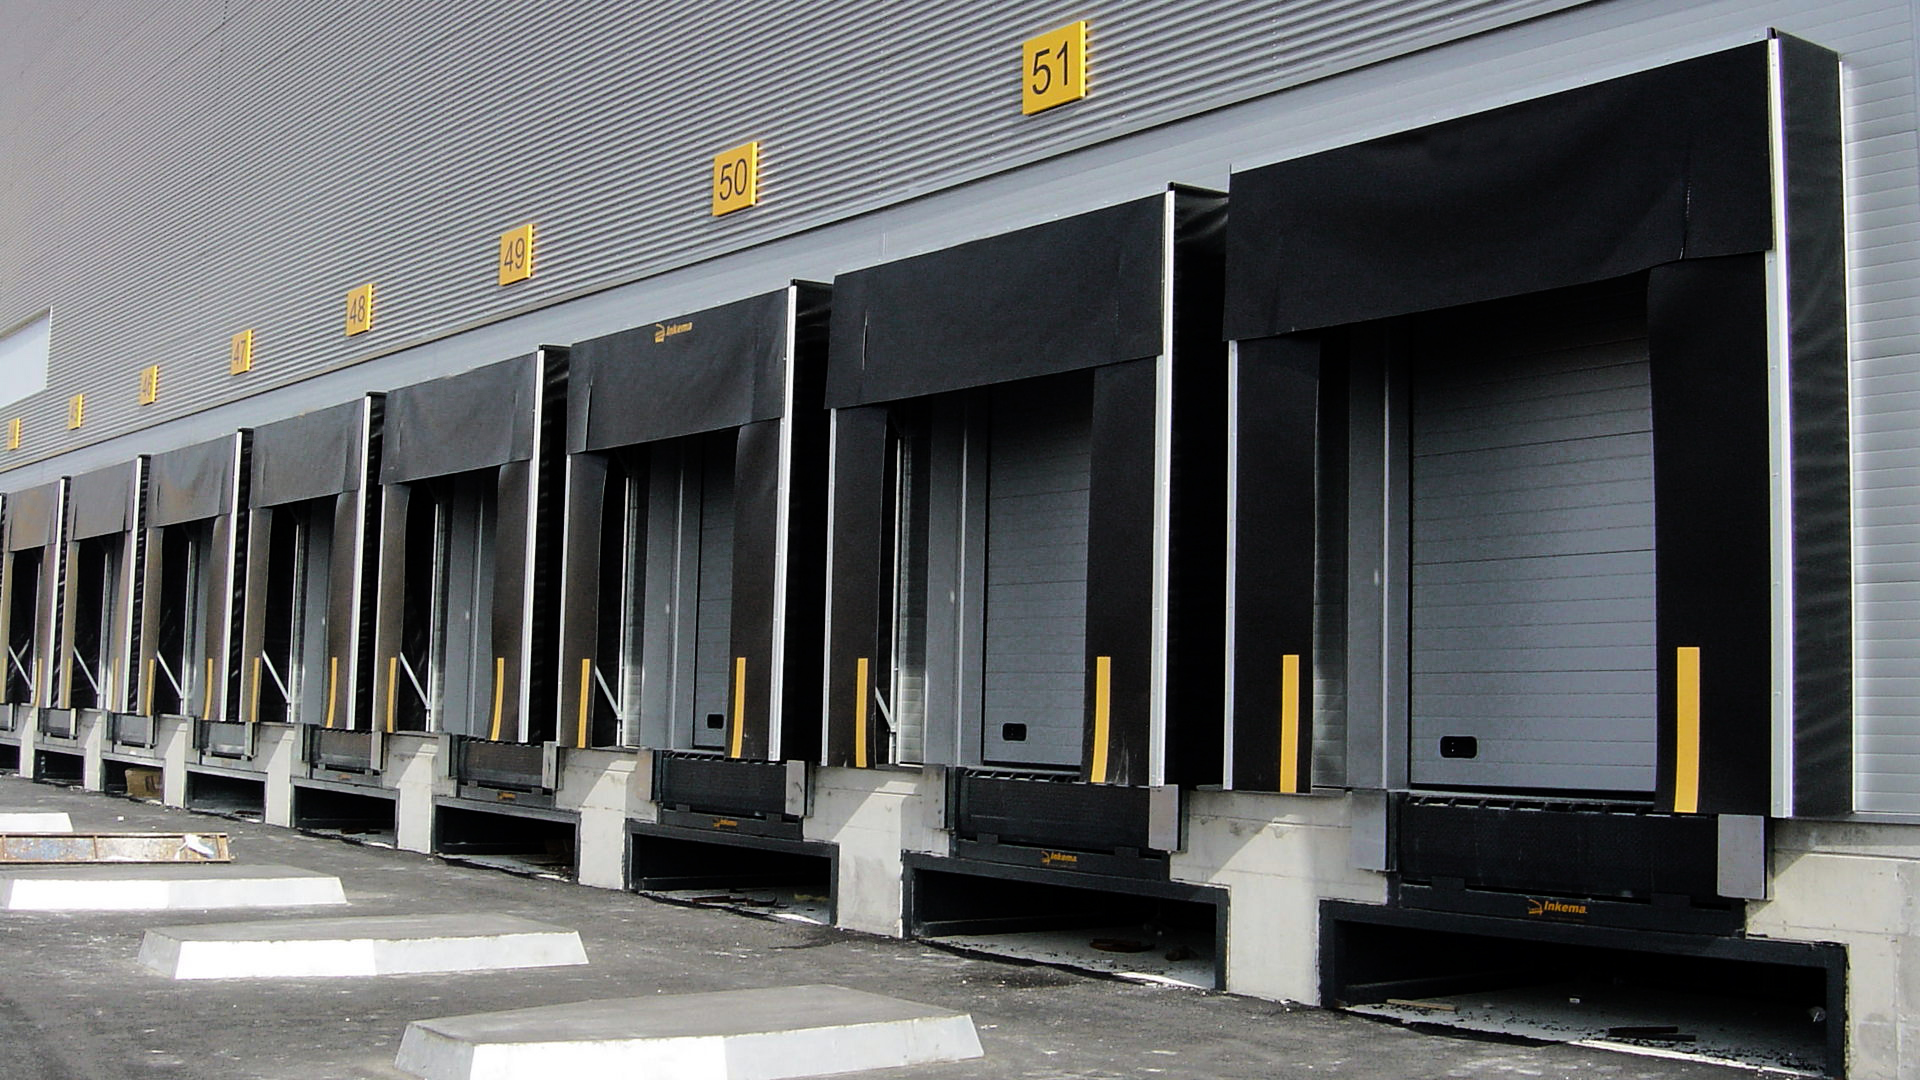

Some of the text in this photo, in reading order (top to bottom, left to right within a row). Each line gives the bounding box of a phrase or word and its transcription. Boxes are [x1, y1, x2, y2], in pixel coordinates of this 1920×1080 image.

[1032, 40, 1068, 95] 51
[719, 158, 748, 200] 50
[504, 237, 525, 272] 49
[350, 295, 366, 324] 48
[665, 321, 693, 336] Inkema
[233, 339, 247, 364] 47
[1543, 900, 1588, 914] Inkema
